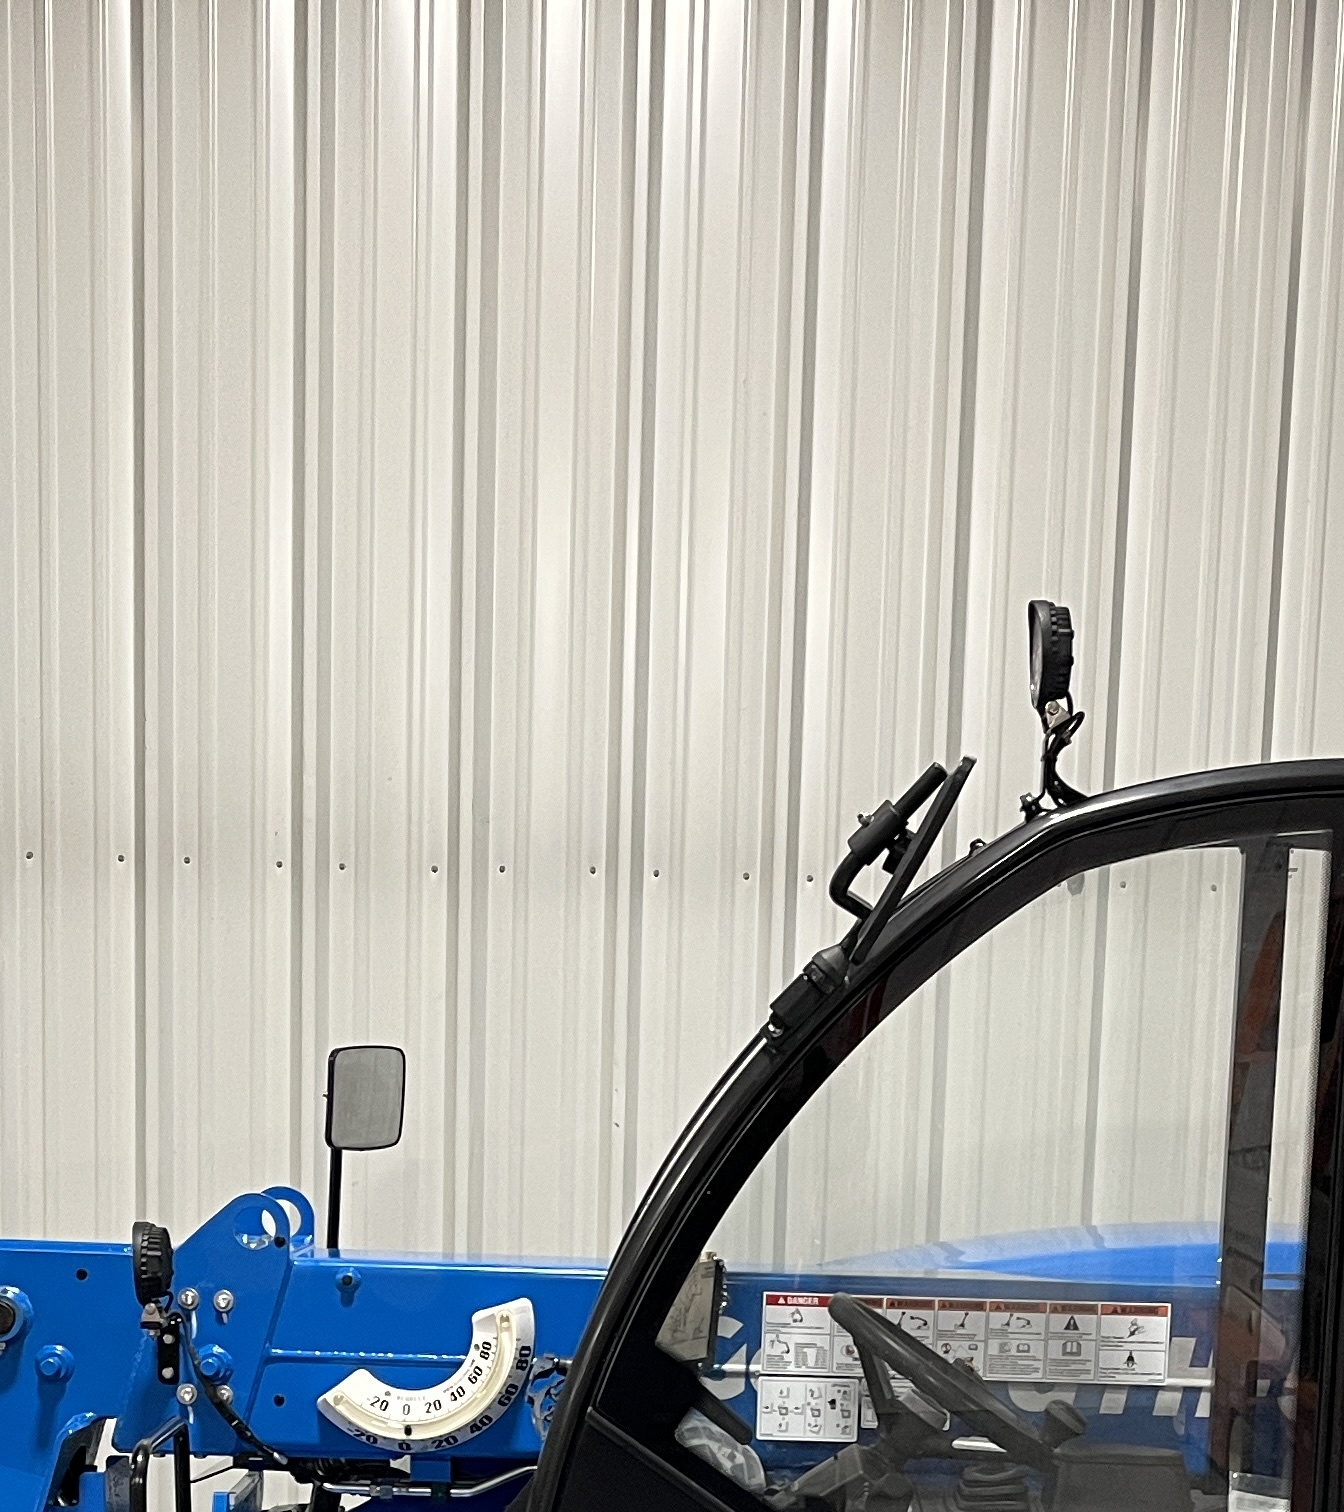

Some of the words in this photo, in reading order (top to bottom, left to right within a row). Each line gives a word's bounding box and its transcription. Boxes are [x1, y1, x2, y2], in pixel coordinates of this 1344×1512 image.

[398, 1441, 412, 1451] 0
[431, 1435, 459, 1449] 20
[469, 1414, 493, 1435] 40
[497, 1383, 519, 1407] 60
[515, 1345, 532, 1372] 80
[402, 1404, 411, 1416] 0
[424, 1399, 442, 1414] 20
[450, 1385, 466, 1402] 40
[467, 1365, 483, 1385] 60
[479, 1341, 492, 1360] 80
